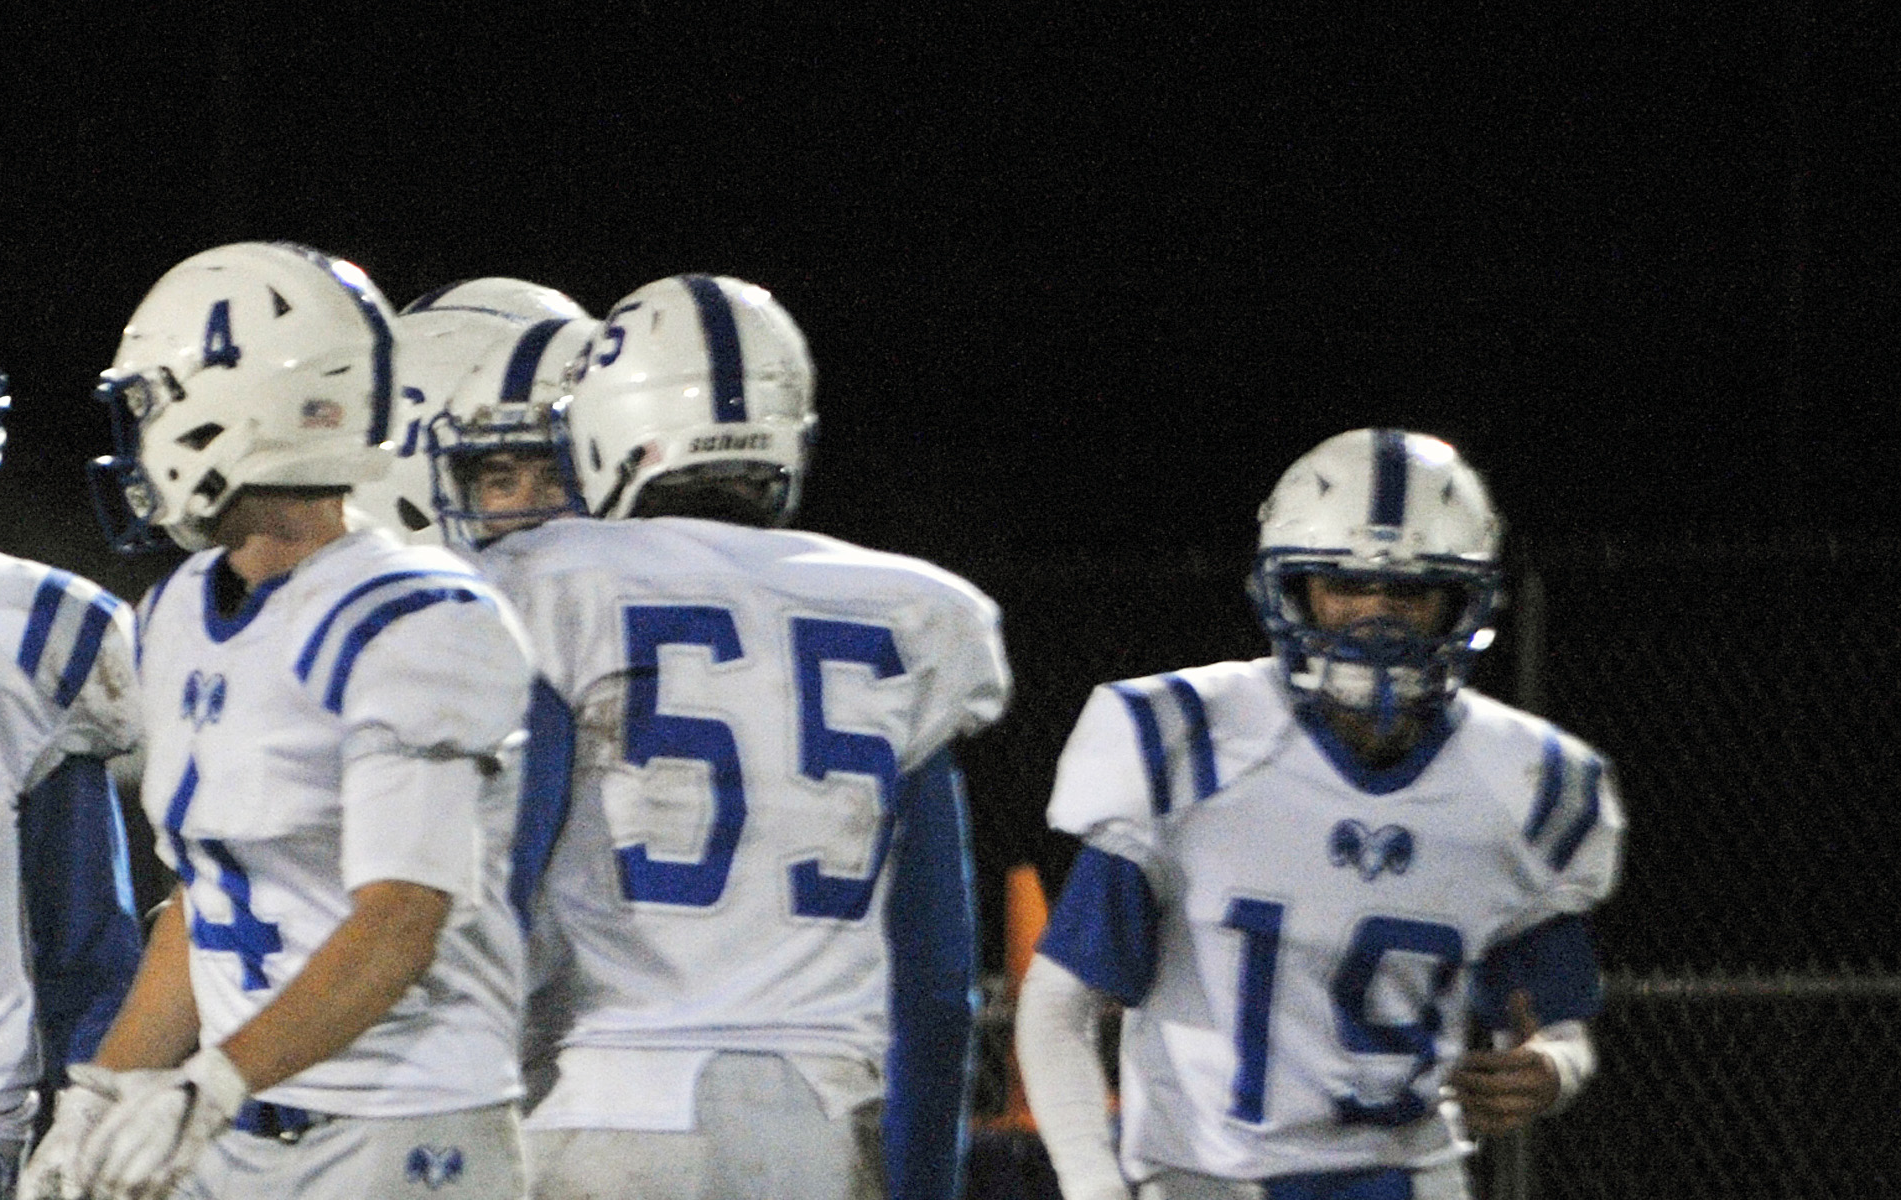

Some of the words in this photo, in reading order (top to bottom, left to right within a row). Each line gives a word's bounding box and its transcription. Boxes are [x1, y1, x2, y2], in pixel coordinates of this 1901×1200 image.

[203, 299, 241, 369] 4
[613, 605, 907, 922] 55
[1223, 897, 1465, 1126] 19
